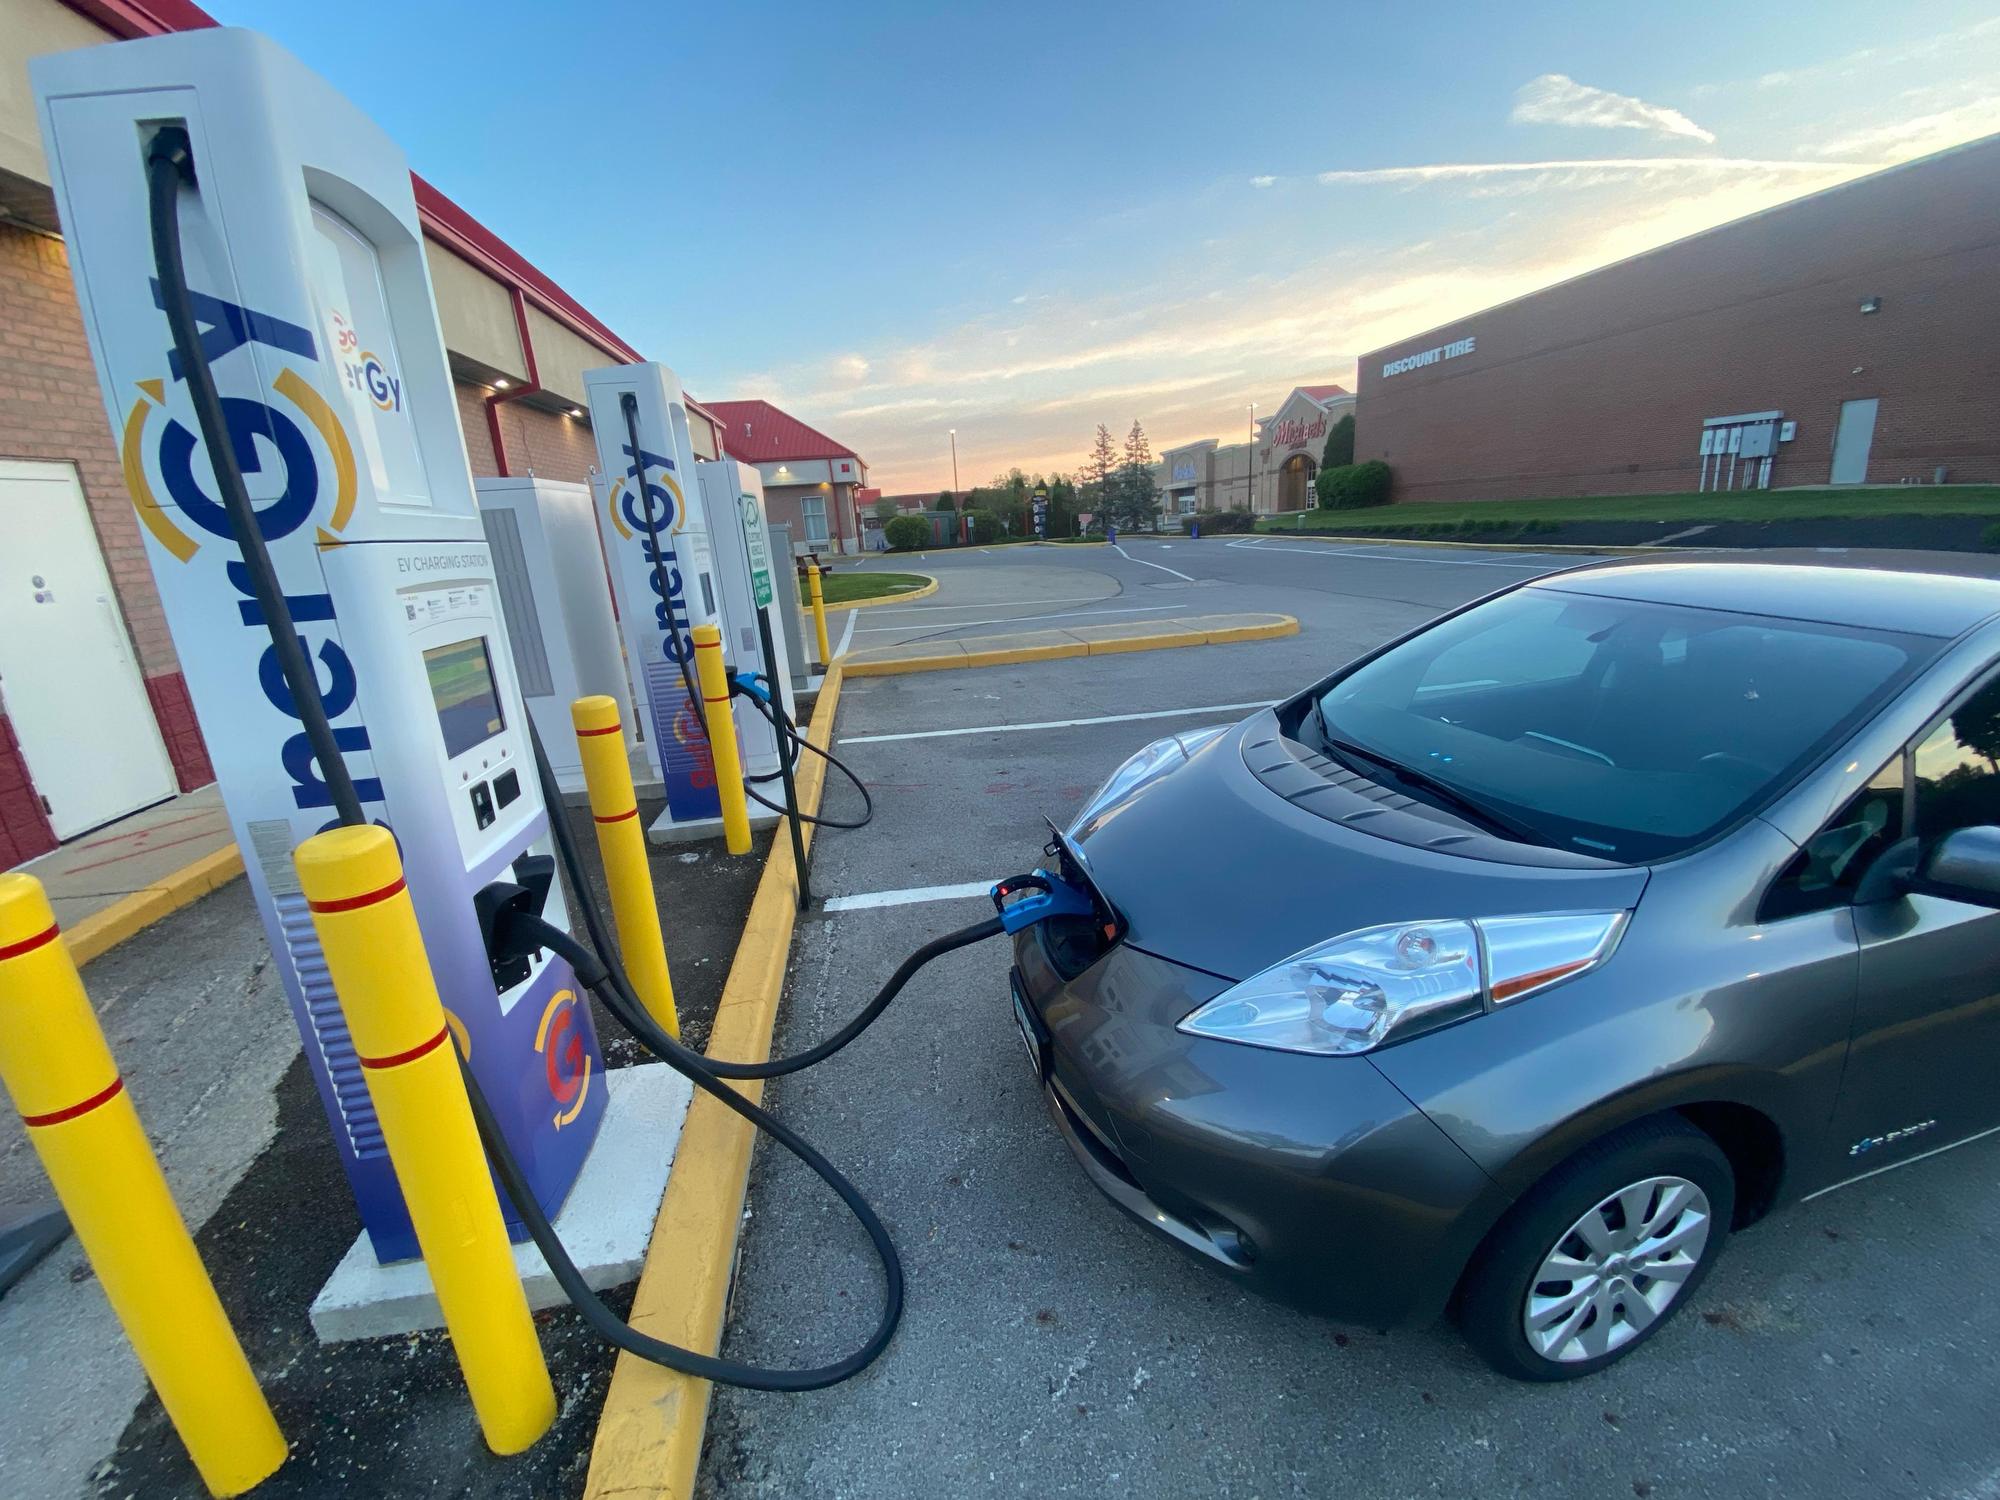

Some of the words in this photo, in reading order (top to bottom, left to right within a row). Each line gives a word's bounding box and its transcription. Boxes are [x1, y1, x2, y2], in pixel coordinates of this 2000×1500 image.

[1383, 347, 1442, 378] DISCOUNT
[1443, 336, 1477, 359] TIRE
[148, 276, 404, 868] nerGy
[398, 557, 411, 572] EV
[413, 555, 461, 571] CHARGING
[622, 443, 695, 664] enerGy
